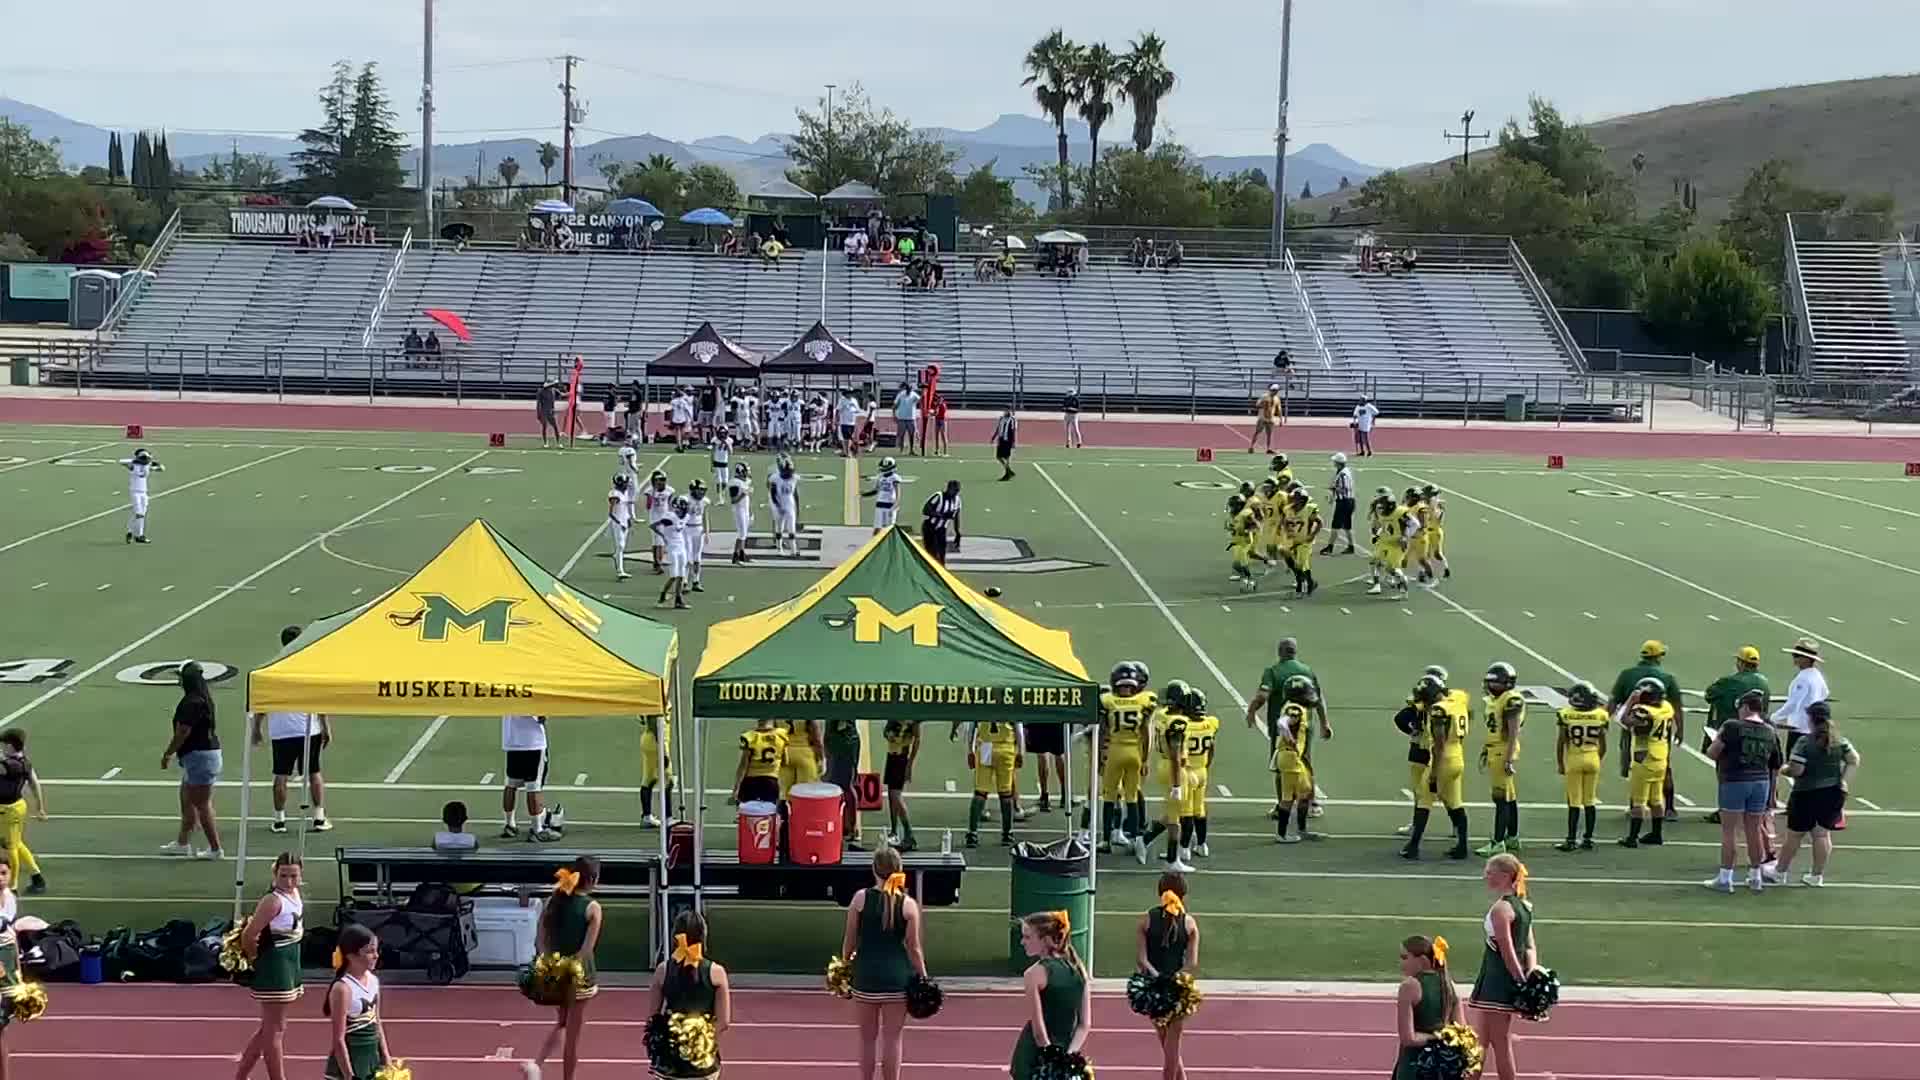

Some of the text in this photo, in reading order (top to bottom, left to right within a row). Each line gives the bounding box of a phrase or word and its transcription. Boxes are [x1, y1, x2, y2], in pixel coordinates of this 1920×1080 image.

[230, 212, 286, 234] THOUSAND
[411, 592, 527, 643] M
[847, 596, 945, 646] M
[377, 680, 534, 698] MUSKETEERS
[718, 682, 1083, 706] MOORPARK YOUTH FOOTBALL & CHEER
[1112, 710, 1138, 733] 15
